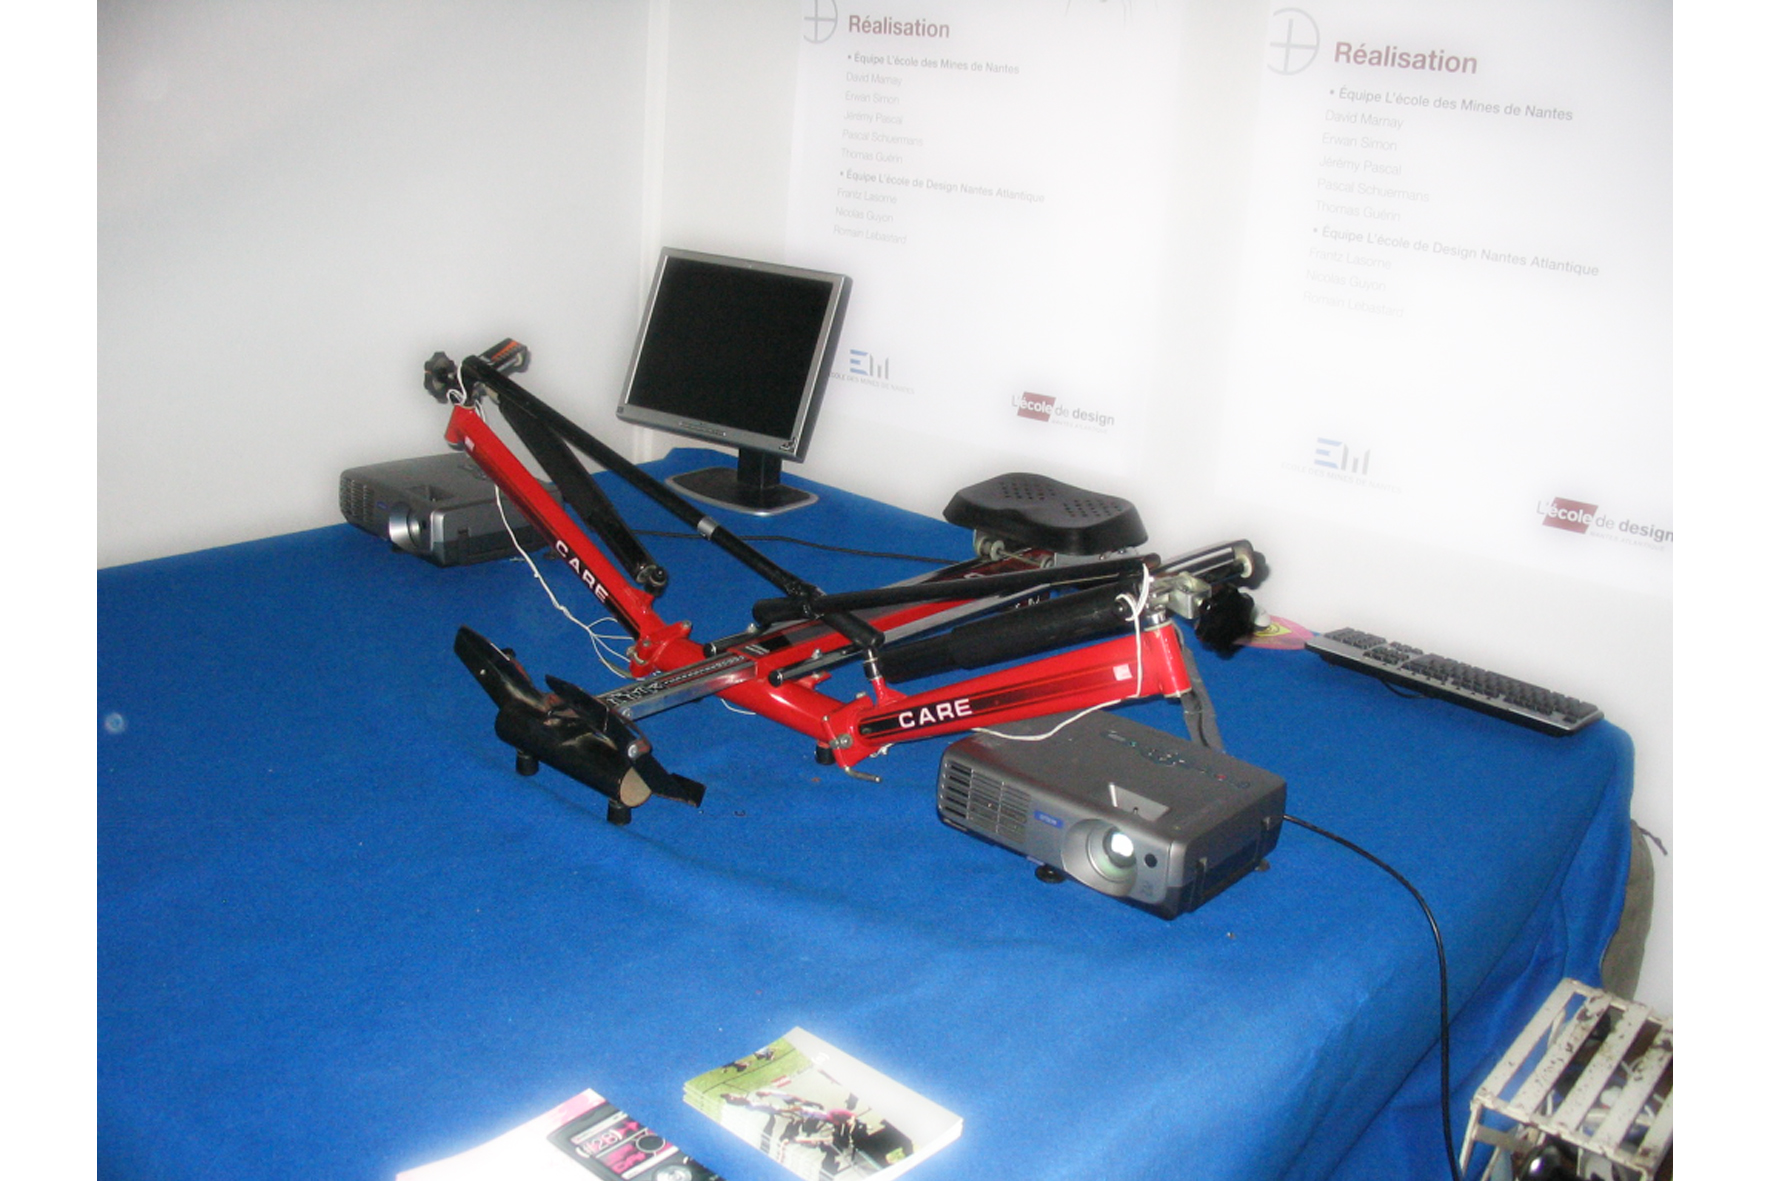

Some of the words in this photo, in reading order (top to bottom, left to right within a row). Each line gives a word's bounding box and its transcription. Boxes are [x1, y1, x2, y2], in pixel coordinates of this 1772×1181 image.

[848, 15, 950, 38] Réalisation
[854, 51, 884, 65] Équipe
[887, 55, 918, 67] L'école
[921, 58, 937, 69] des
[940, 59, 968, 70] Mines
[971, 62, 983, 71] de
[985, 62, 1019, 74] Nantes
[1334, 41, 1478, 74] Réalisation
[1339, 85, 1381, 105] Équipe
[1385, 92, 1429, 107] L'école
[1433, 96, 1457, 109] des
[1461, 98, 1500, 114] Mines
[1503, 103, 1521, 116] de
[1524, 103, 1573, 121] Nantes
[1325, 109, 1357, 125] David
[1360, 113, 1404, 131] Marnay
[1322, 133, 1357, 147] Erwan
[1360, 137, 1397, 151] Simon
[1319, 155, 1359, 173] Jérémy
[1364, 160, 1401, 175] Pascal
[846, 169, 876, 183] Équipe
[879, 172, 910, 186] L'école
[912, 178, 924, 188] de
[926, 180, 958, 193] Design
[960, 184, 993, 196] Nantes
[995, 188, 1045, 203] Atlantique
[1317, 178, 1354, 194] Pascal
[1358, 182, 1429, 202] Schuermans
[1316, 200, 1359, 217] Thomas
[1363, 205, 1401, 221] Guérin
[1309, 247, 1343, 263] Frantz
[1347, 252, 1391, 270] Lasorne
[1322, 224, 1363, 243] Équipe
[1367, 231, 1409, 249] L'école
[1413, 239, 1429, 251] de
[1433, 242, 1477, 260] Design
[1480, 249, 1526, 266] Nantes
[1530, 255, 1599, 276] Atlantique
[1307, 269, 1346, 285] Nicolas
[1349, 274, 1386, 291] Guyon
[1303, 291, 1344, 308] Romain
[1347, 297, 1404, 318] Lebastard
[1011, 394, 1053, 414] L'école
[1055, 404, 1069, 418] de
[1072, 408, 1115, 426] design
[1536, 500, 1592, 524] L'école
[1595, 514, 1615, 529] de
[1619, 520, 1673, 542] design
[554, 540, 608, 603] CARE
[899, 699, 973, 728] CARE
